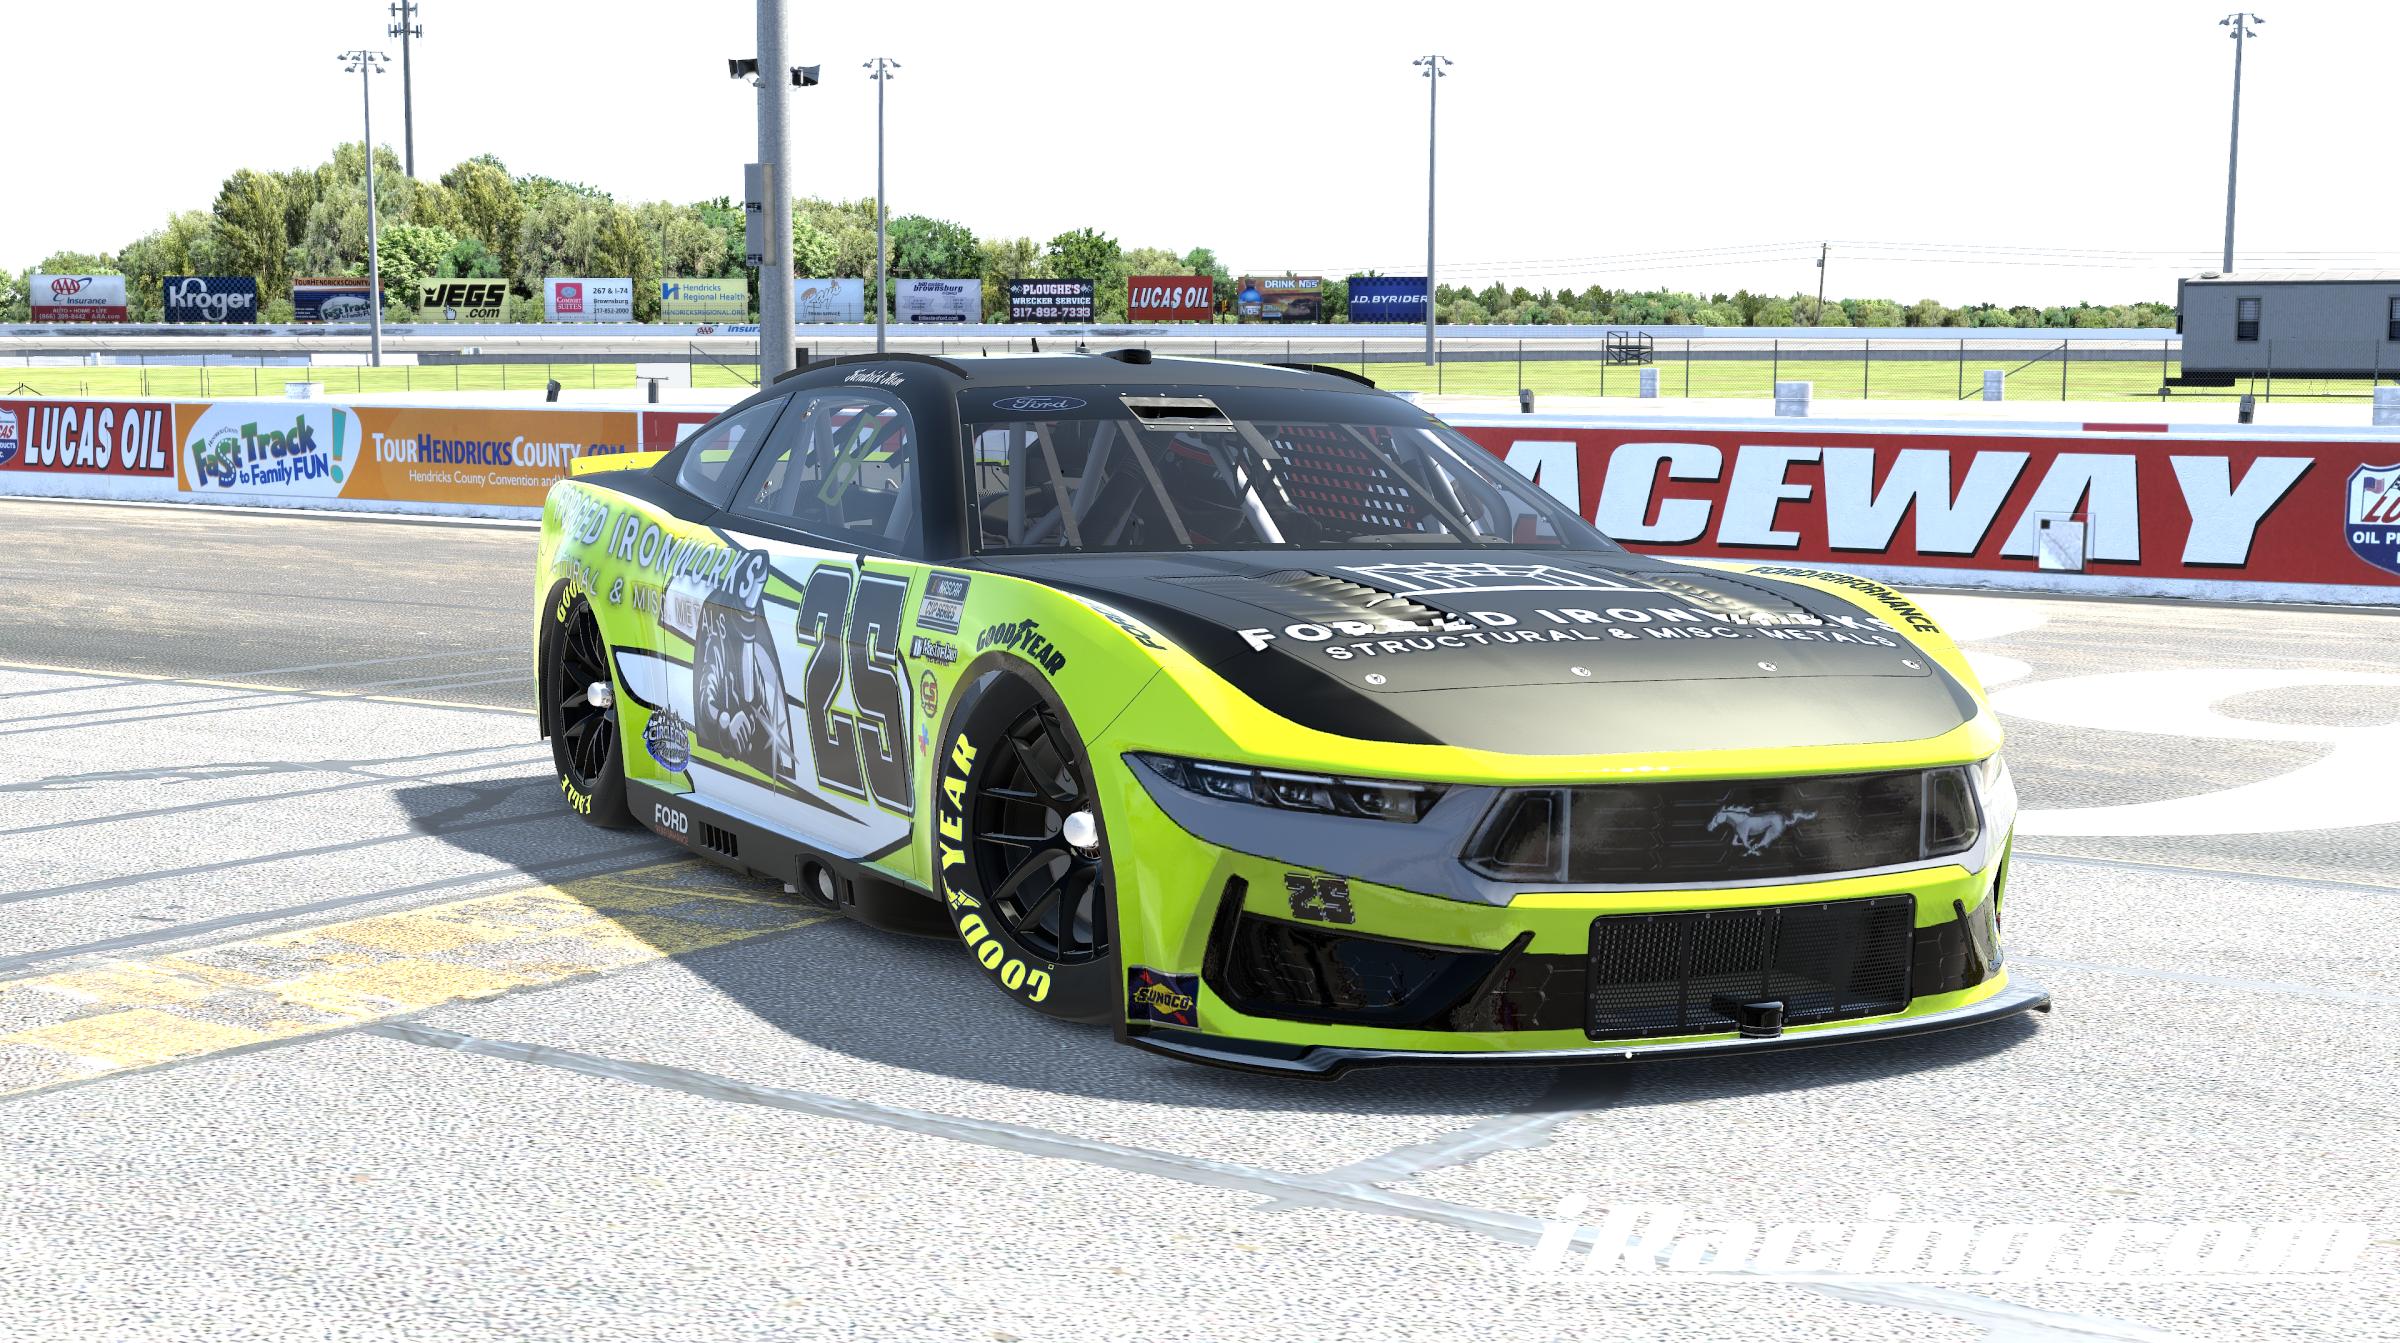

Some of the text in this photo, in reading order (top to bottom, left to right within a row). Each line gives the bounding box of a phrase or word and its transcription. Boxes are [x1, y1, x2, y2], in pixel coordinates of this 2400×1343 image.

[51, 278, 80, 295] AAA
[423, 284, 506, 307] JEGS
[1023, 284, 1081, 294] PLOUGHE'S
[1264, 280, 1296, 288] DRINK
[67, 297, 107, 305] Insurance
[168, 278, 253, 321] Kroger
[684, 293, 717, 302] Regional
[1131, 287, 1209, 309] LUCAS OIL
[1351, 295, 1428, 303] J.D. BYRIDER
[465, 308, 499, 318] .com
[1013, 307, 1091, 317] 317-892-7333
[1011, 397, 1068, 409] Ford
[25, 405, 166, 470] LUCAS OIL
[192, 414, 317, 488] Fast Track
[239, 470, 250, 484] to
[251, 460, 293, 486] Family
[409, 470, 452, 482] Hendricks
[453, 471, 486, 488] County
[488, 472, 539, 486] Convention
[541, 476, 557, 486] and
[1503, 440, 2316, 566] ACEWAY
[2352, 531, 2380, 544] OIL
[608, 511, 763, 606] IRONWORKS
[938, 579, 962, 598] NASCAR
[609, 577, 624, 604] &
[675, 597, 727, 640] METALS
[1746, 566, 1940, 635] FORD PERFORMANCE
[976, 618, 1066, 676] GOODYEAR
[1326, 626, 1897, 660] STRUCTURAL & MISC. METALS
[797, 564, 914, 817] 25
[561, 773, 592, 815] EAGLE
[655, 802, 689, 834] FORD
[938, 732, 1053, 1003] GOODYEAR
[1136, 987, 1191, 1010] SUNOCO
